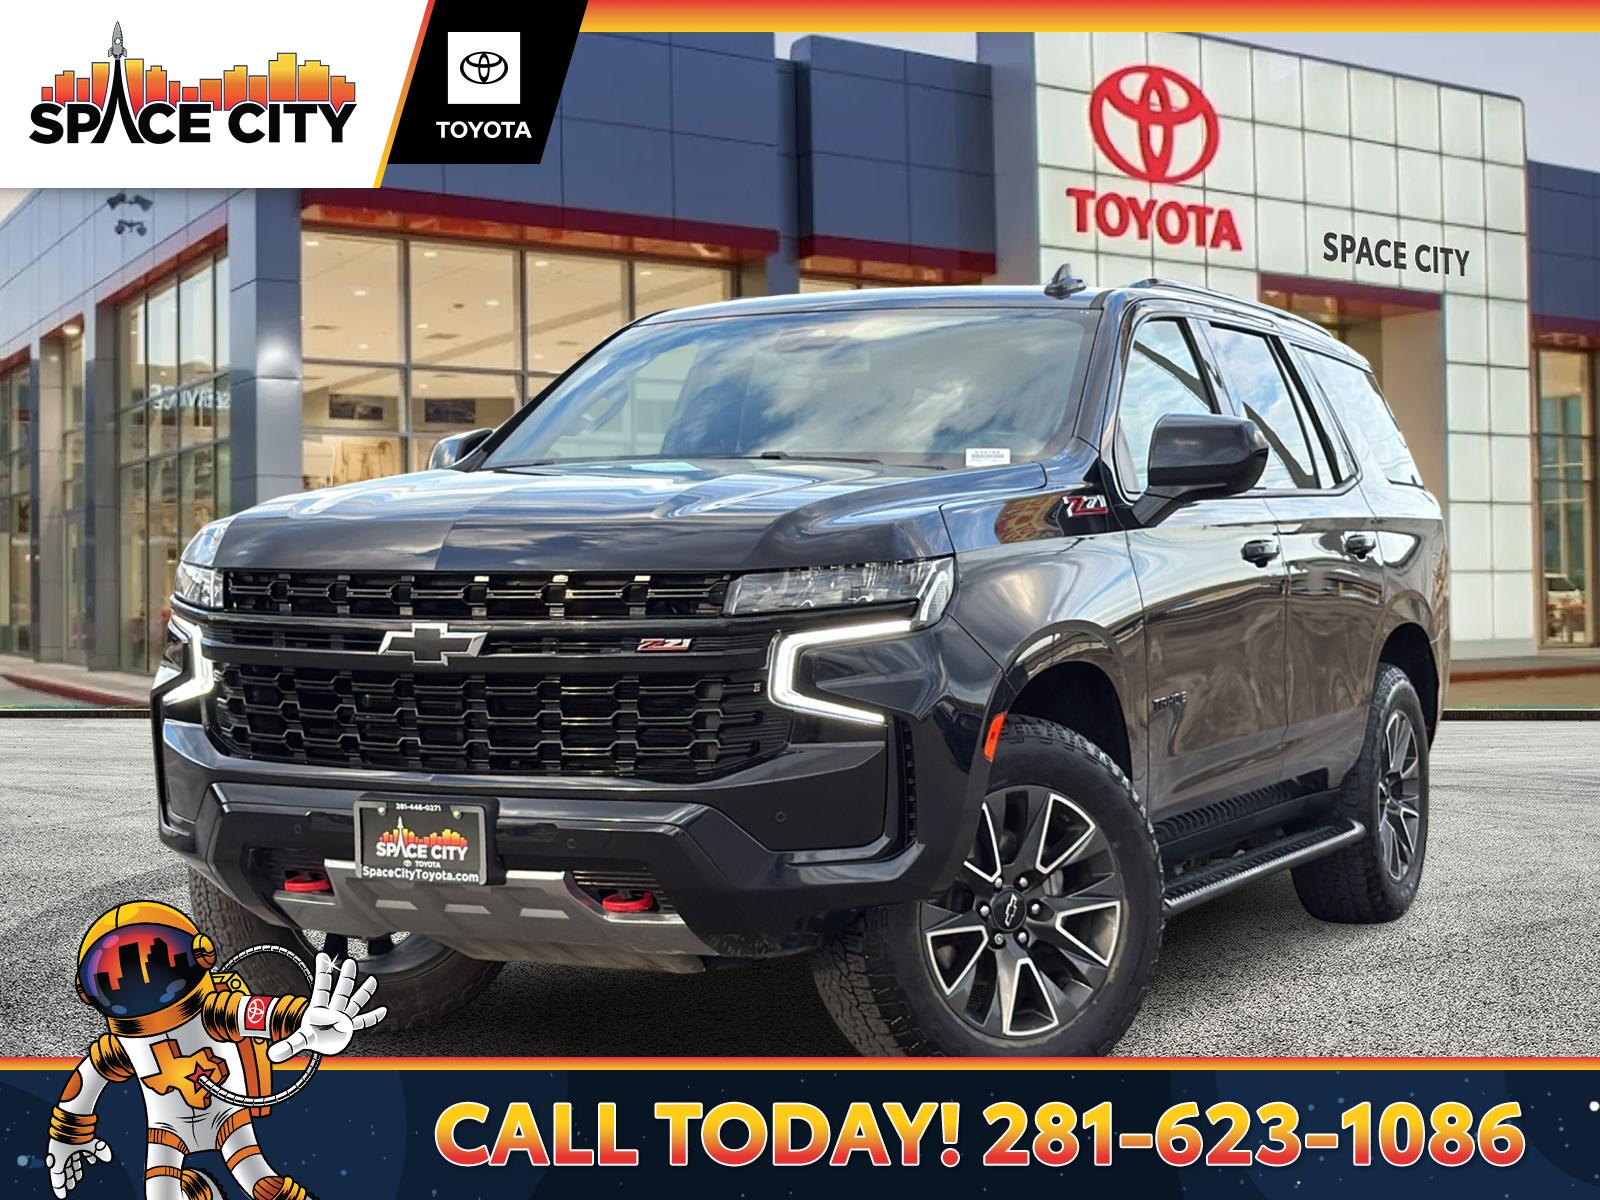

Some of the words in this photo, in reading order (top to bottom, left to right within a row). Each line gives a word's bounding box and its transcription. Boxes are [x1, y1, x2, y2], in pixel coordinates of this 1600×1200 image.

[1066, 187, 1242, 250] TOYOTA
[1323, 231, 1407, 270] SPACE
[1414, 244, 1470, 277] CITY
[1062, 494, 1108, 518] Z71
[637, 638, 692, 651] Z71
[430, 844, 468, 861] CITY
[415, 860, 442, 869] TOYOTA
[362, 866, 479, 883] SpaceCityToyota.com
